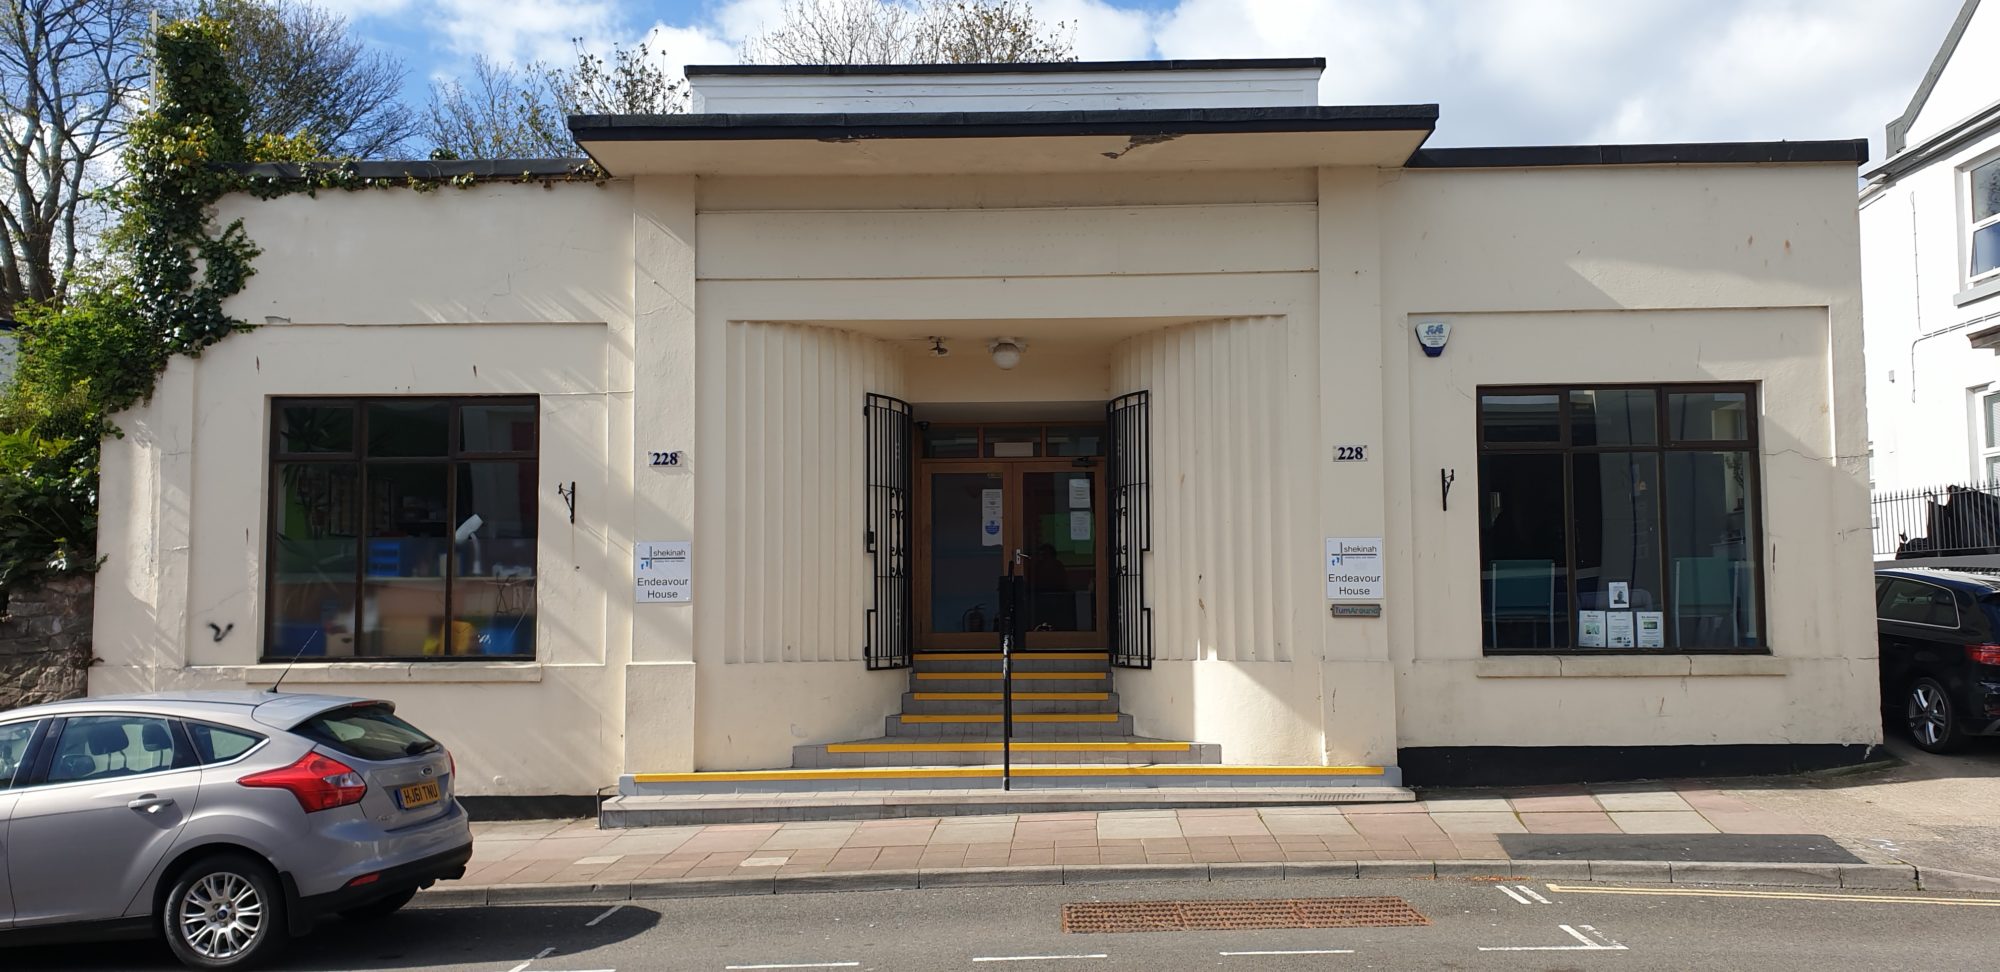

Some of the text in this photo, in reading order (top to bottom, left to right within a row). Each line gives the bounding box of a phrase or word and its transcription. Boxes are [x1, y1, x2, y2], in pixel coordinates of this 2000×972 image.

[1337, 446, 1364, 460] 228
[653, 452, 678, 465] 228
[1343, 545, 1377, 553] shekinah
[637, 577, 688, 586] Endeavour
[1328, 573, 1381, 583] Endeavour
[647, 590, 678, 599] House
[1339, 586, 1370, 595] House
